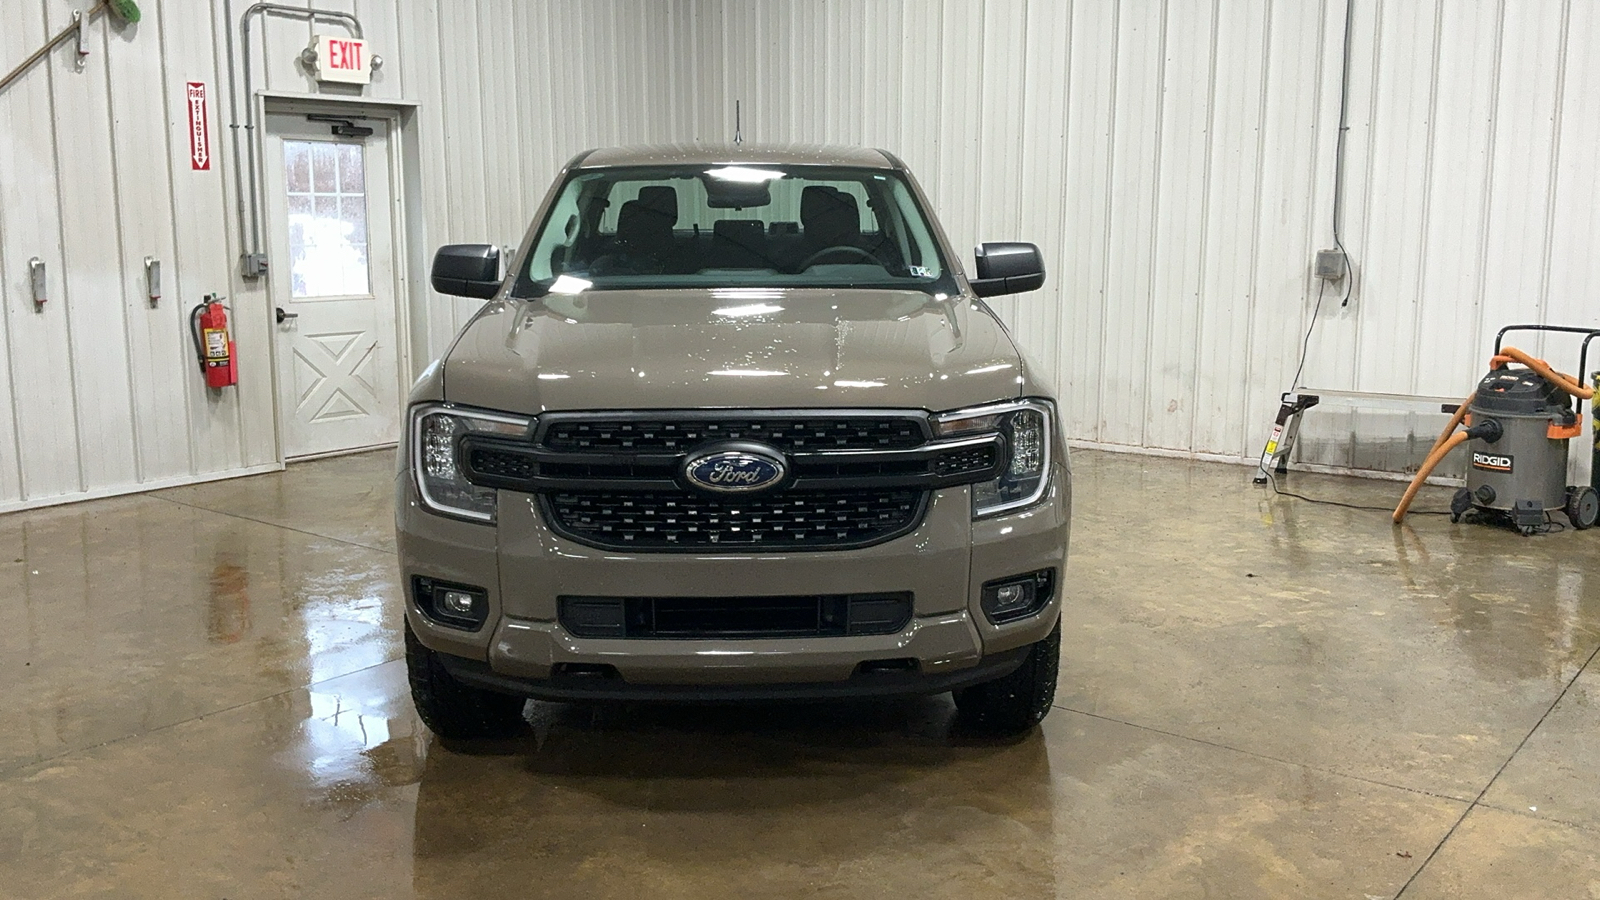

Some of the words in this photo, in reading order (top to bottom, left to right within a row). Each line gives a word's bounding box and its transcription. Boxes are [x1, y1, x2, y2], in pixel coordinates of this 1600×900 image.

[329, 40, 362, 70] EXIT
[189, 89, 203, 98] FIRE
[195, 100, 203, 162] EXTINGUISHER
[1473, 453, 1511, 467] RIDGID
[709, 463, 761, 484] Ford
